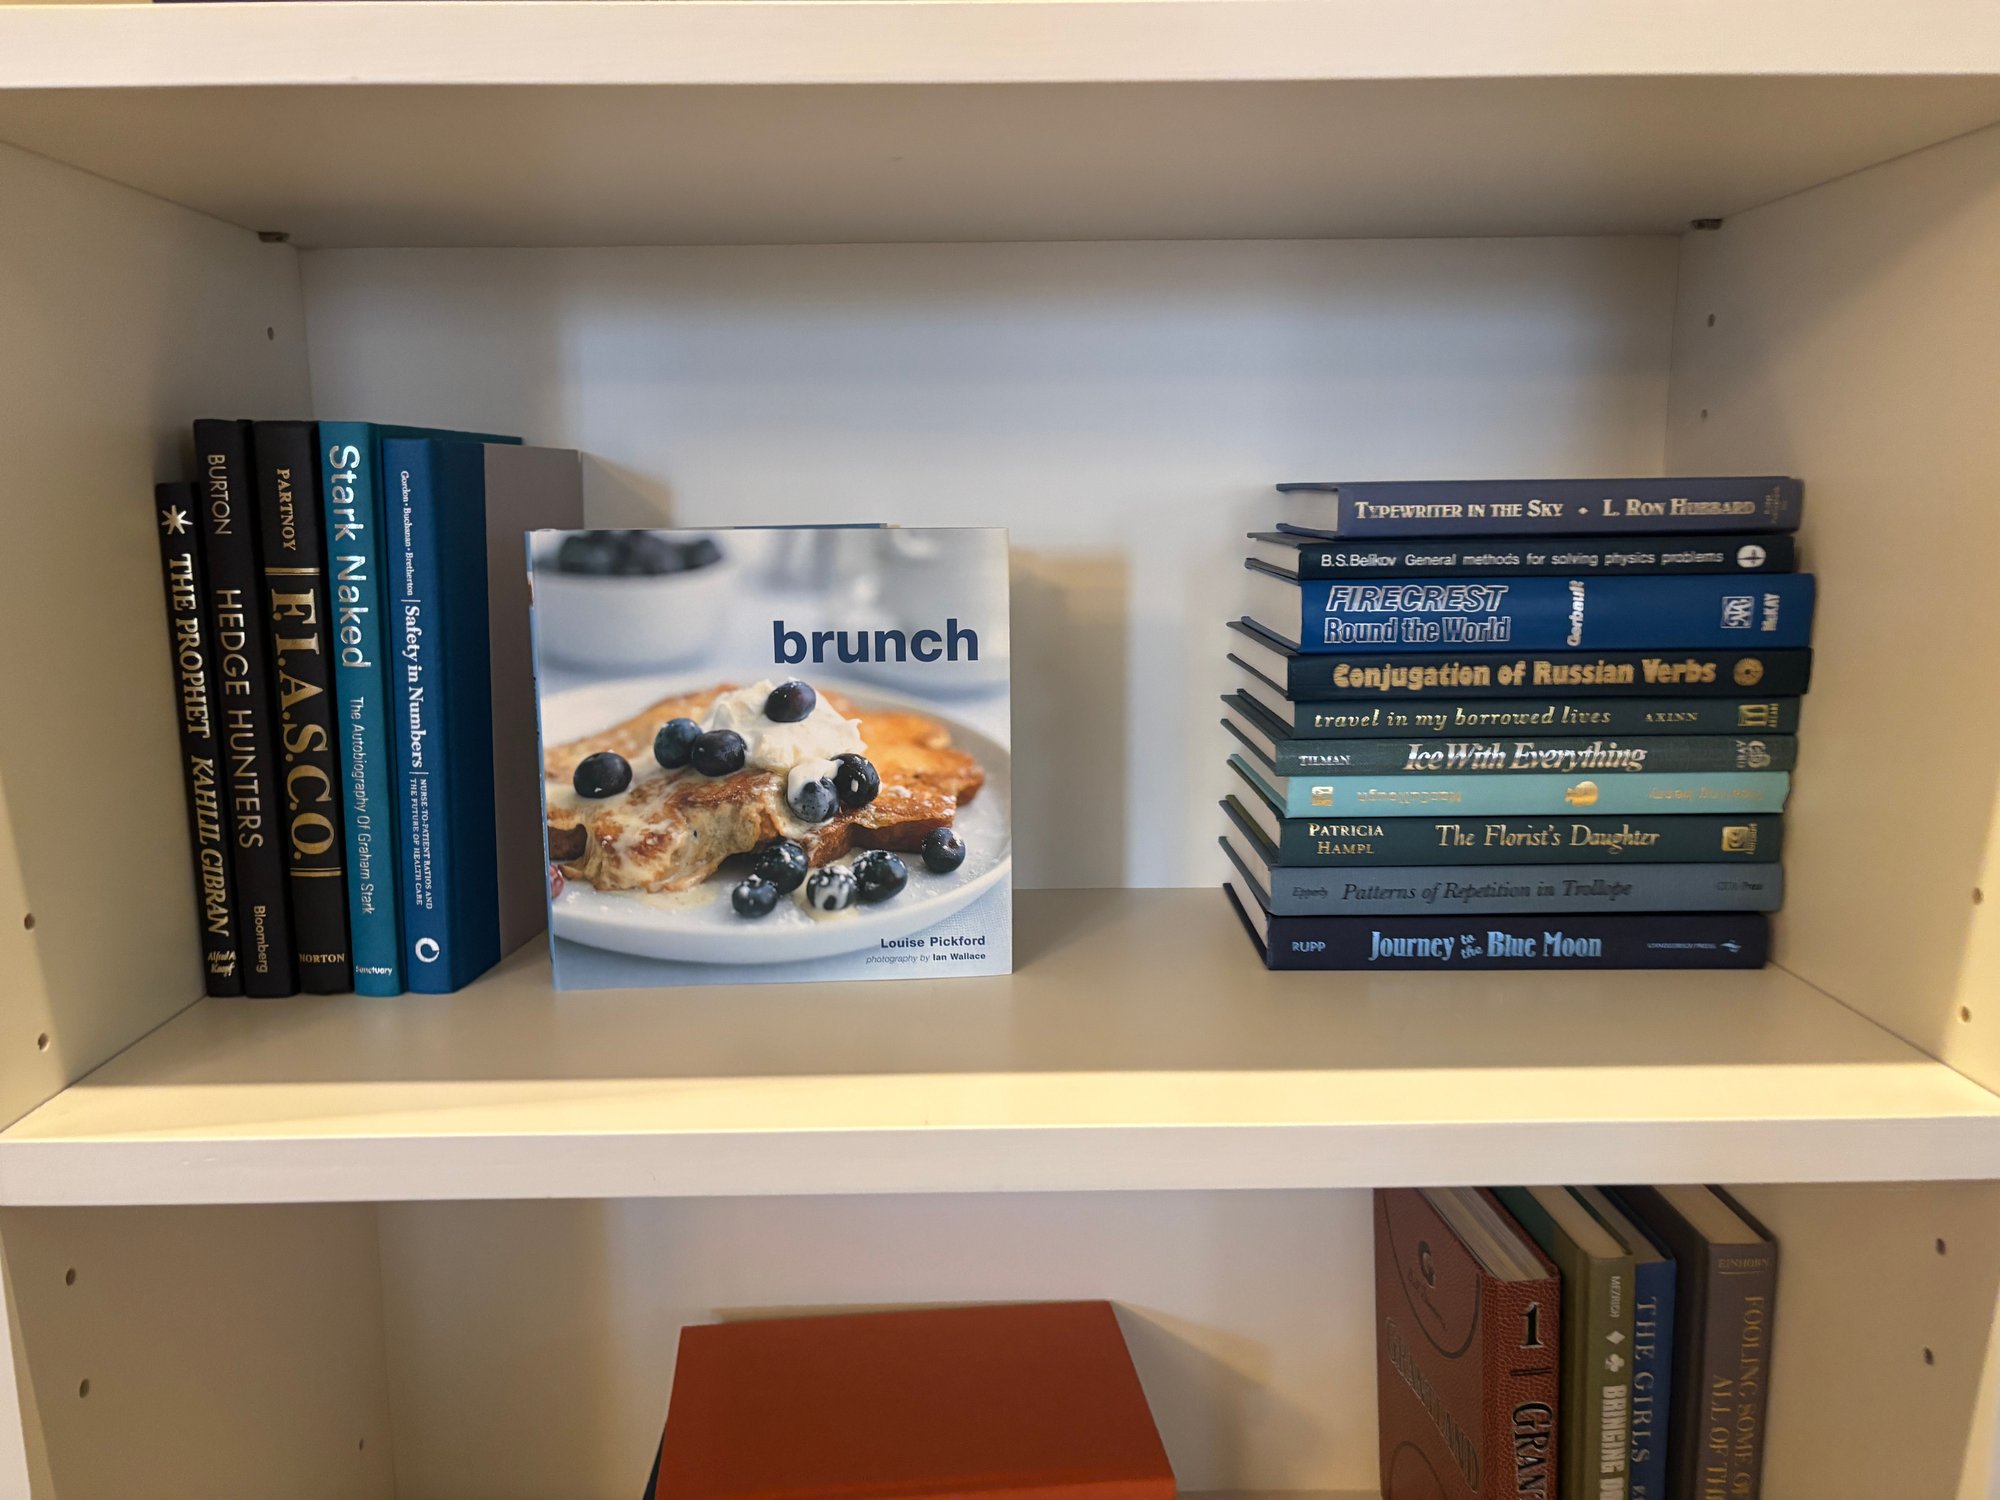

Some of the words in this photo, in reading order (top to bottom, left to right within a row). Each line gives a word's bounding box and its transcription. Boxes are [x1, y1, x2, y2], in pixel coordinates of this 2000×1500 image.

[207, 454, 232, 534] BURTON
[329, 445, 364, 541] Stark
[400, 470, 411, 502] Gordon
[276, 468, 296, 550] PARTNOY
[1354, 501, 1462, 519] TYPEWRITER
[1468, 504, 1485, 517] IN
[1490, 503, 1522, 517] THE
[1527, 499, 1564, 517] SKY
[1602, 499, 1621, 517] L.
[1625, 499, 1667, 516] RON
[403, 507, 413, 547] Buchanan
[405, 552, 414, 596] Bretherton
[1405, 553, 1456, 566] General
[1463, 553, 1520, 565] methods
[1527, 553, 1546, 565] for
[1551, 552, 1598, 567] solving
[1604, 552, 1655, 567] physics
[1661, 551, 1724, 565] problems
[169, 553, 196, 611] THE
[336, 555, 371, 667] Naked
[1325, 585, 1509, 612] FIRECREST
[215, 589, 250, 695] HEDGE
[402, 605, 423, 662] Safety
[773, 618, 979, 664] brunch
[1324, 617, 1398, 643] Round
[1401, 617, 1439, 642] the
[1442, 616, 1511, 643] World
[175, 617, 210, 738] PROPHET
[408, 664, 423, 683] in
[1333, 662, 1491, 692] Conjugation
[1497, 660, 1526, 686] of
[1532, 660, 1635, 685] Russian
[1641, 658, 1717, 684] Verbs
[350, 697, 364, 720] The
[1314, 708, 1380, 728] travel
[1386, 711, 1408, 726] in
[1415, 715, 1448, 731] my
[1454, 706, 1555, 726] borrowed
[1561, 706, 1611, 724] lives
[1645, 712, 1698, 722] AXINN
[409, 686, 427, 768] Numbers
[351, 724, 368, 813] Autobiography
[1403, 743, 1443, 771] Ice
[1445, 742, 1506, 770] With
[1509, 741, 1648, 772] Everything
[227, 710, 264, 848] HUNTERS
[410, 778, 418, 796] THE
[191, 755, 220, 845] KAHLIL
[411, 798, 420, 833] FUTURE
[357, 815, 371, 832] Of
[1308, 822, 1385, 837] PATRICIA
[1435, 824, 1475, 847] The
[1484, 824, 1561, 846] Florist's
[1569, 823, 1661, 855] Daughter
[413, 834, 420, 846] OF
[1317, 841, 1374, 855] HAMPL
[357, 833, 374, 880] Graham
[414, 848, 422, 881] HEALTH
[424, 860, 432, 890] RATIOS
[201, 849, 229, 937] GIBRAN
[360, 883, 375, 914] Stark
[415, 882, 423, 906] CARE
[1343, 883, 1416, 901] Patterns
[1421, 882, 1442, 904] of
[1443, 881, 1531, 904] Repetition
[1537, 881, 1555, 896] in
[1562, 879, 1633, 901] Trollope
[253, 905, 269, 973] Bloomberg
[880, 938, 925, 948] Louise
[930, 935, 986, 947] Pickford
[1292, 941, 1326, 952] RUPP
[1368, 930, 1455, 962] Journey
[1459, 934, 1477, 945] to
[1459, 944, 1484, 960] the
[1486, 930, 1537, 958] Blue
[1543, 931, 1602, 957] Moon
[299, 953, 345, 963] NORTON
[866, 954, 918, 964] photography
[920, 954, 930, 962] by
[933, 953, 947, 961] Ian
[950, 952, 986, 961] Wallace
[1718, 1258, 1771, 1269] EINHORN
[1520, 1301, 1545, 1349] 1
[1634, 1296, 1657, 1360] THE
[1738, 1296, 1765, 1398] FOOLING
[1711, 1374, 1734, 1421] ALL
[1600, 1384, 1627, 1473] BRINGING
[1631, 1372, 1655, 1463] GIRLS
[1709, 1426, 1730, 1456] OF
[1734, 1404, 1756, 1466] SOME
